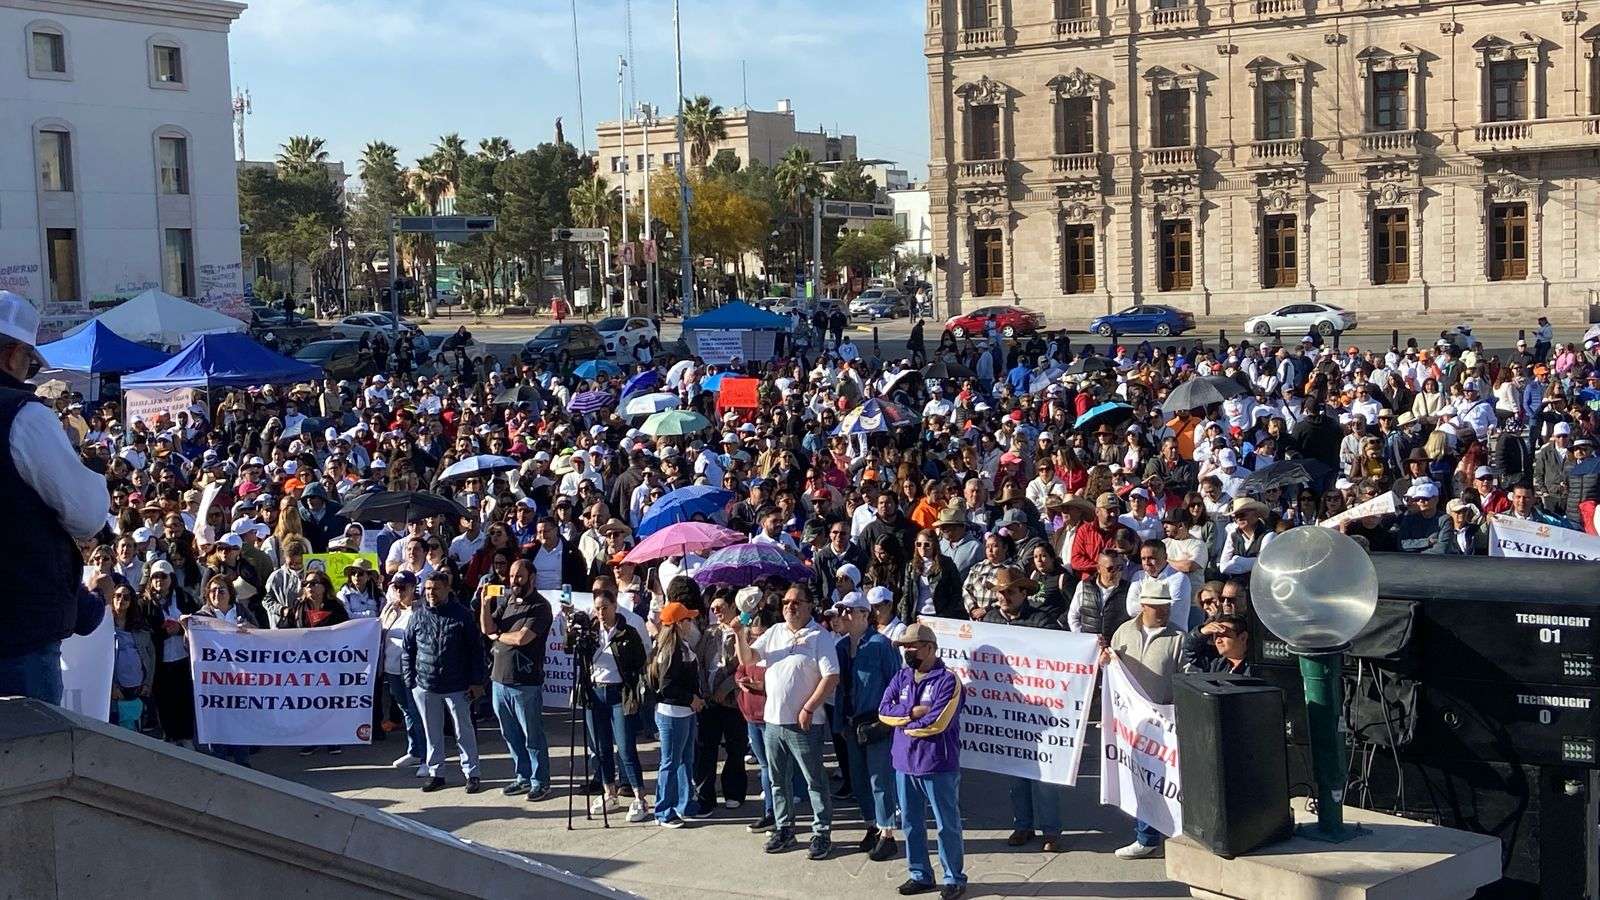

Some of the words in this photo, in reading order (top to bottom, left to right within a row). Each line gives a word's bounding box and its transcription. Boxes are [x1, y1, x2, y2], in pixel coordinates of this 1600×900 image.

[1516, 613, 1591, 627] TECHNOLIGHT
[1539, 628, 1561, 643] 01
[201, 645, 369, 664] BASIFICACIÓN
[937, 647, 969, 661] ERA
[972, 650, 1031, 669] LETICIA
[201, 671, 331, 687] INMEDIATA
[339, 672, 368, 686] DE
[955, 667, 989, 681] YNA
[994, 673, 1056, 690] CASTRO
[1060, 680, 1070, 692] Y
[981, 688, 1065, 710] GRANADOS
[1517, 694, 1592, 708] TECHNOLIGHT
[1002, 709, 1070, 729] TIRANOS
[965, 722, 1044, 744] DERECHOS
